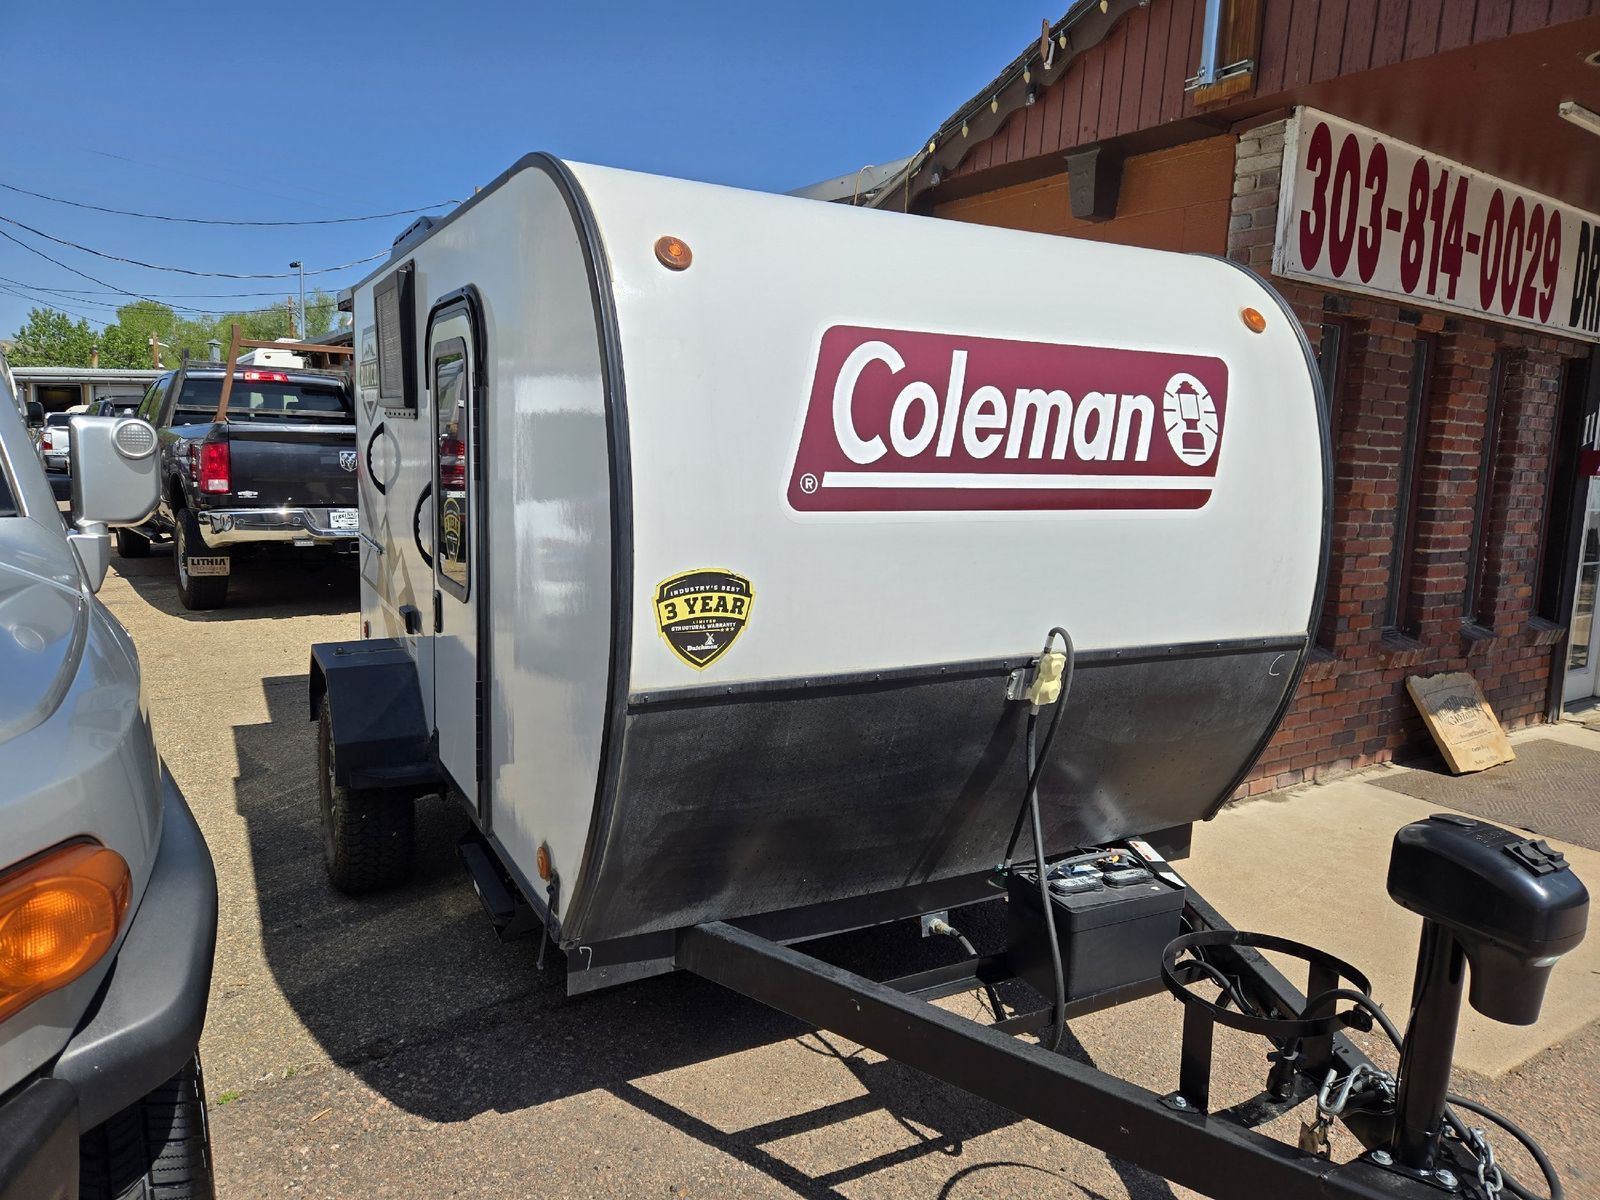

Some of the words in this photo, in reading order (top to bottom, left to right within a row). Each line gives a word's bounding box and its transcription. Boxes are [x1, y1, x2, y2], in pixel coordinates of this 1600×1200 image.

[1299, 121, 1562, 324] 303-814-0029
[1569, 221, 1600, 332] DR
[832, 340, 1155, 465] Coleman
[191, 558, 226, 566] LITHIA
[670, 585, 719, 596] INDUSTRY'S
[721, 585, 740, 593] BEST
[664, 602, 678, 621] 3
[684, 596, 745, 615] YEAR
[671, 624, 706, 632] STRUCTURAL
